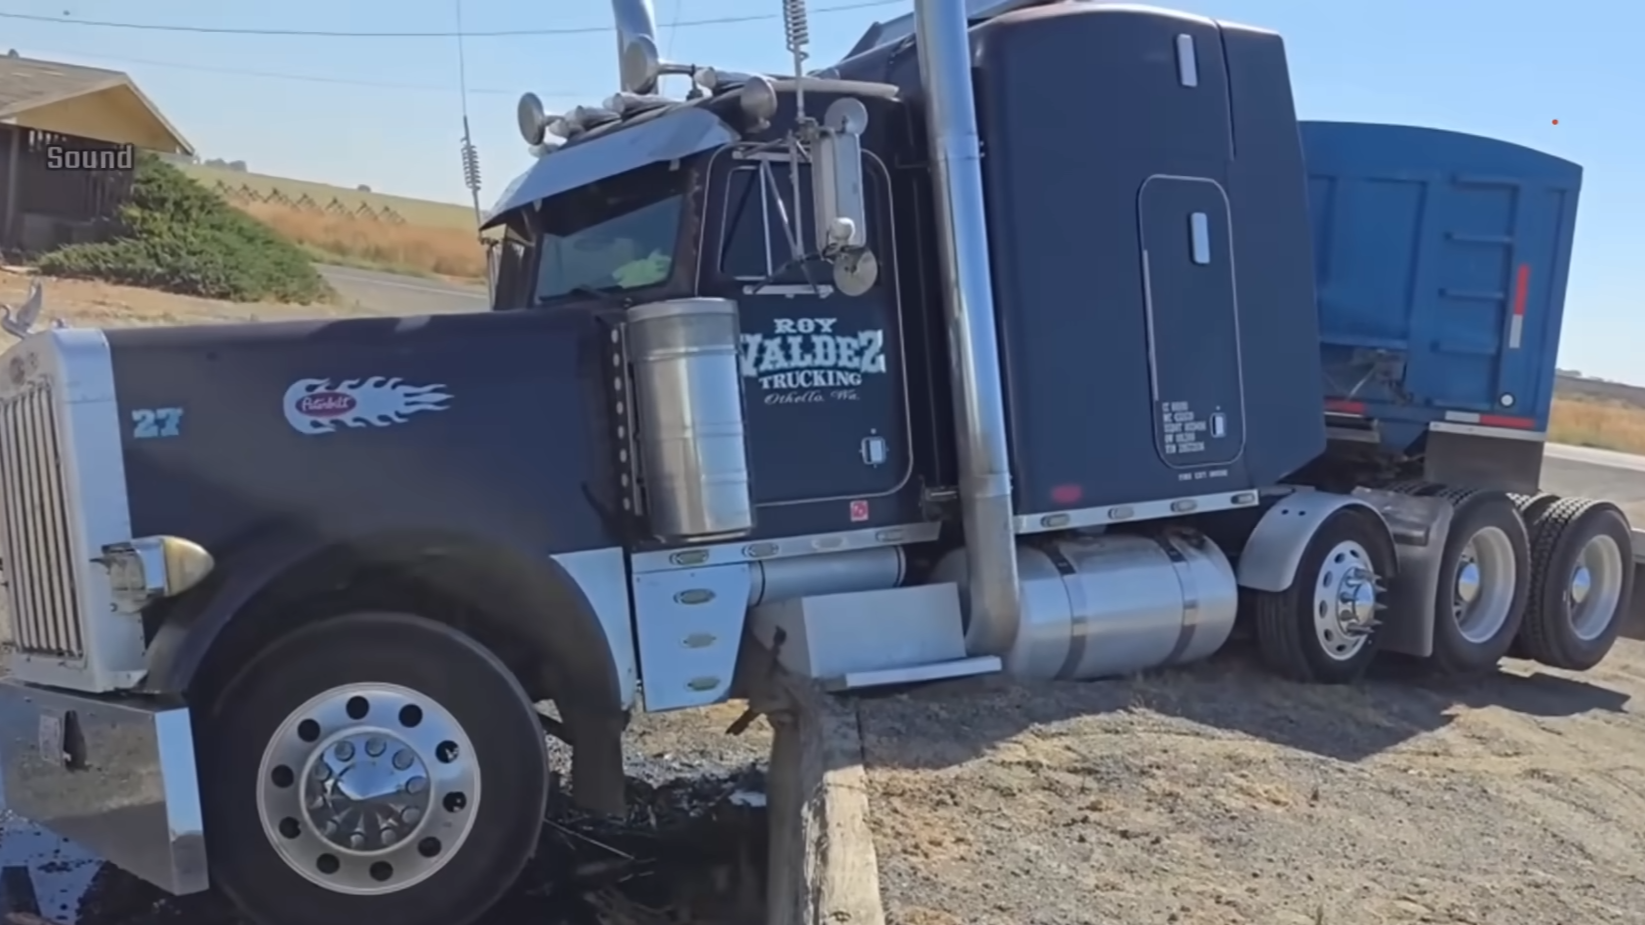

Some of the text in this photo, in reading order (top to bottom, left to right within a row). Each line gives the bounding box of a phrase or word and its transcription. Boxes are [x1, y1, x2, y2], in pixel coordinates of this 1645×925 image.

[773, 318, 837, 334] ROY
[740, 329, 886, 377] VALDEZ
[758, 369, 862, 389] TRUCKING
[132, 407, 183, 438] 27
